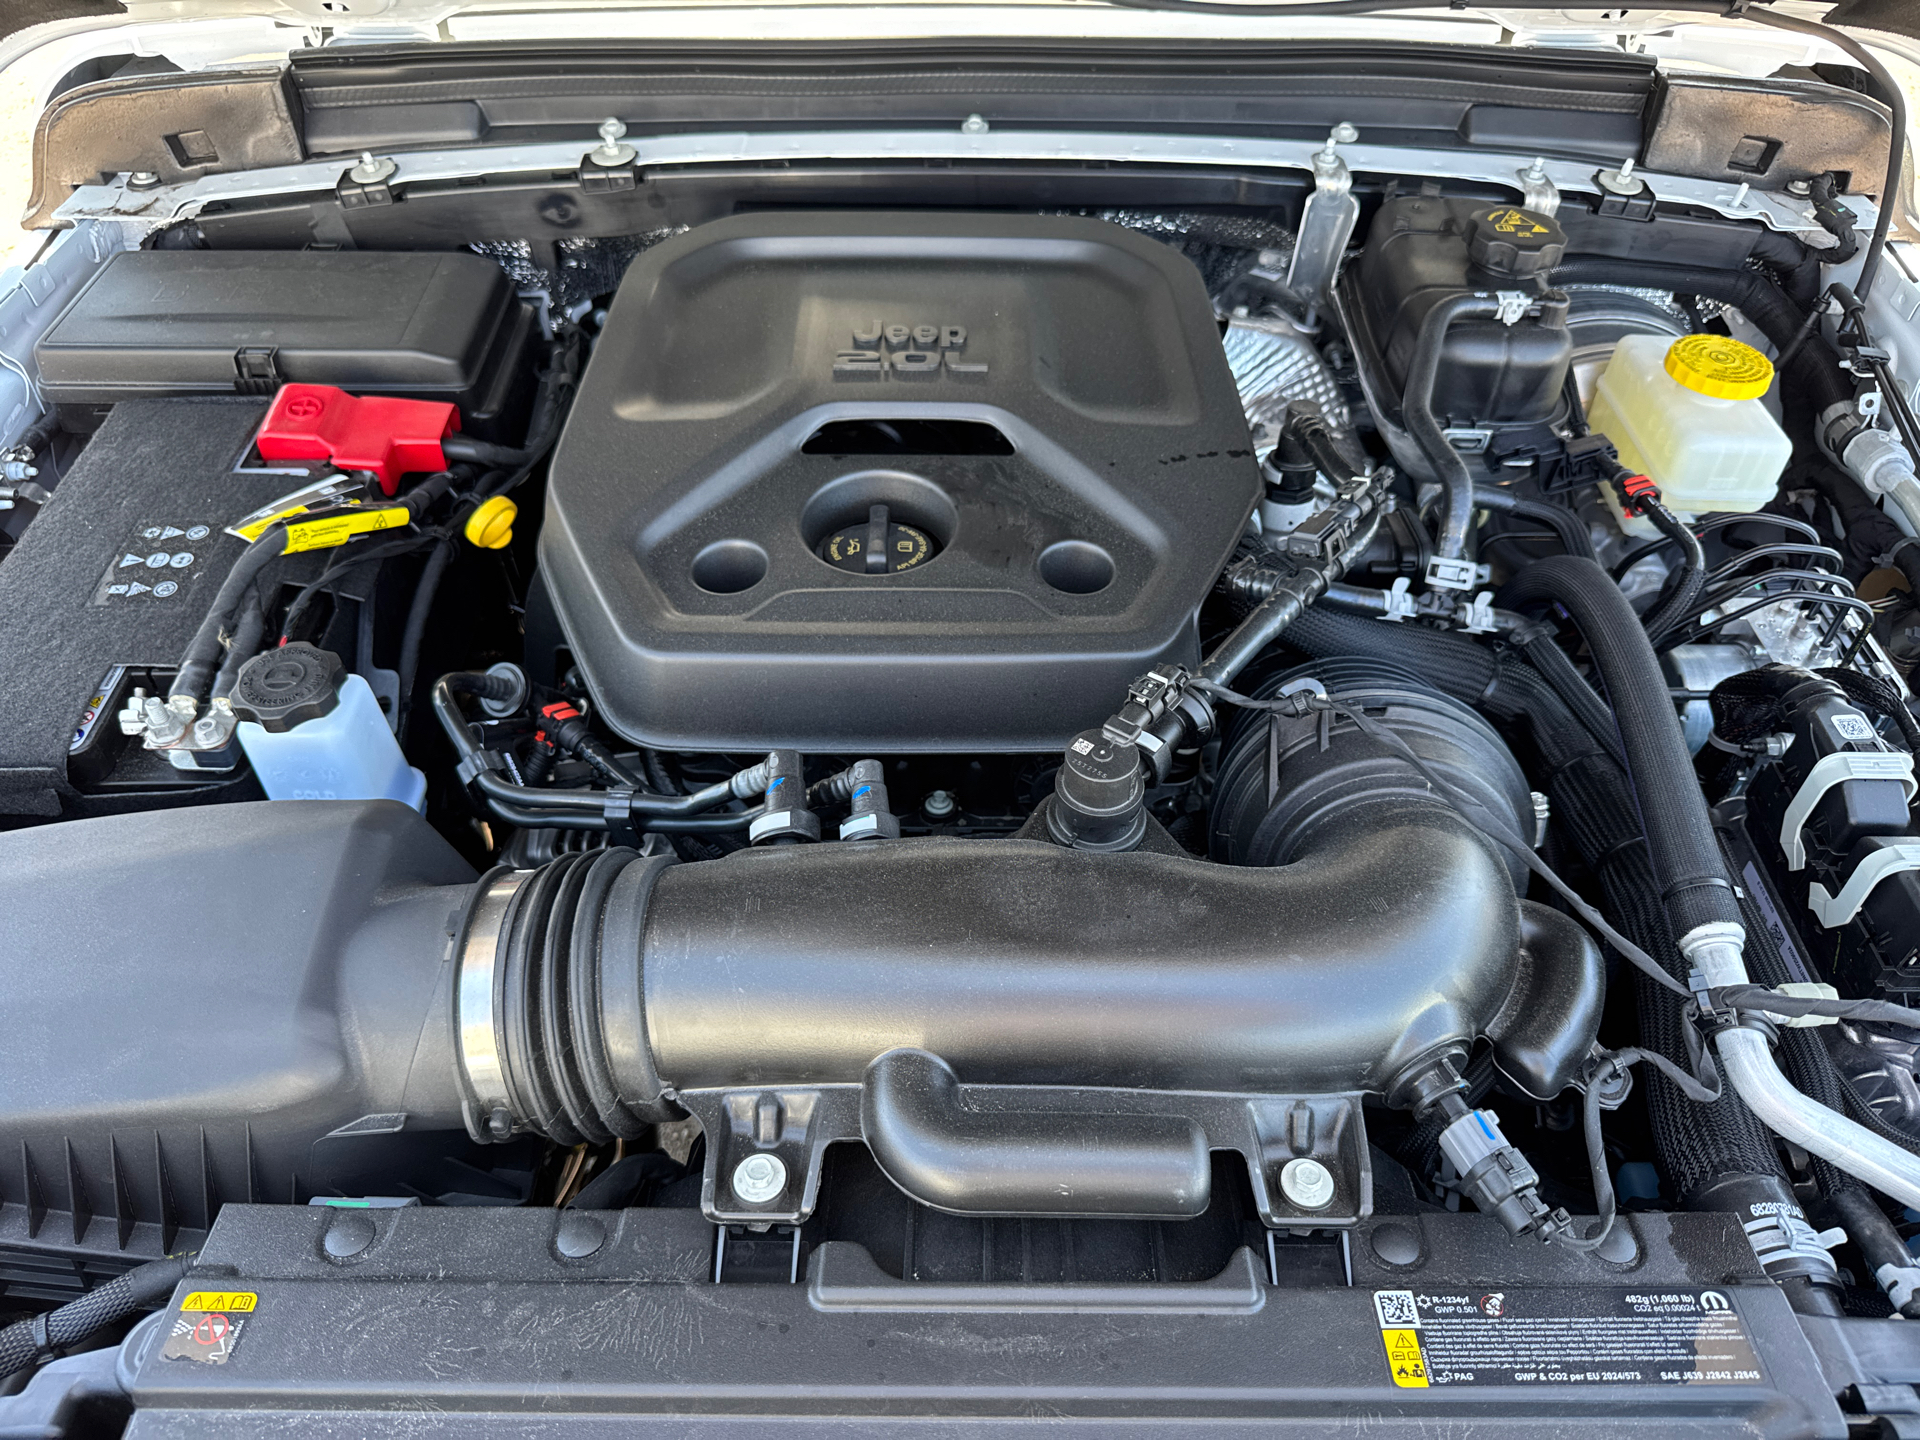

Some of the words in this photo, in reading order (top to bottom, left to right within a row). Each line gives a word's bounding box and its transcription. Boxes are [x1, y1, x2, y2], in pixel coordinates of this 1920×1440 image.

[853, 320, 967, 348] Jeep
[833, 351, 988, 372] 2.0L
[1432, 1296, 1470, 1305] R-1234yf
[1624, 1295, 1649, 1305] 482g
[1649, 1294, 1679, 1304] (1.060
[1680, 1294, 1695, 1304] lb)
[1434, 1306, 1455, 1314] GWP
[1633, 1304, 1652, 1312] CO2
[1653, 1306, 1665, 1314] eq
[1665, 1304, 1696, 1312] 0.00024
[1454, 1373, 1474, 1381] PAG
[1514, 1373, 1537, 1381] GWP
[1539, 1373, 1547, 1381] &
[1548, 1373, 1568, 1381] CO2
[1570, 1374, 1585, 1382] per
[1587, 1373, 1600, 1381] EU
[1601, 1373, 1641, 1381] 2024/573
[1660, 1372, 1681, 1380] SAE
[1682, 1372, 1703, 1380] J639
[1705, 1372, 1732, 1380] J2842
[1733, 1371, 1760, 1380] J2845
